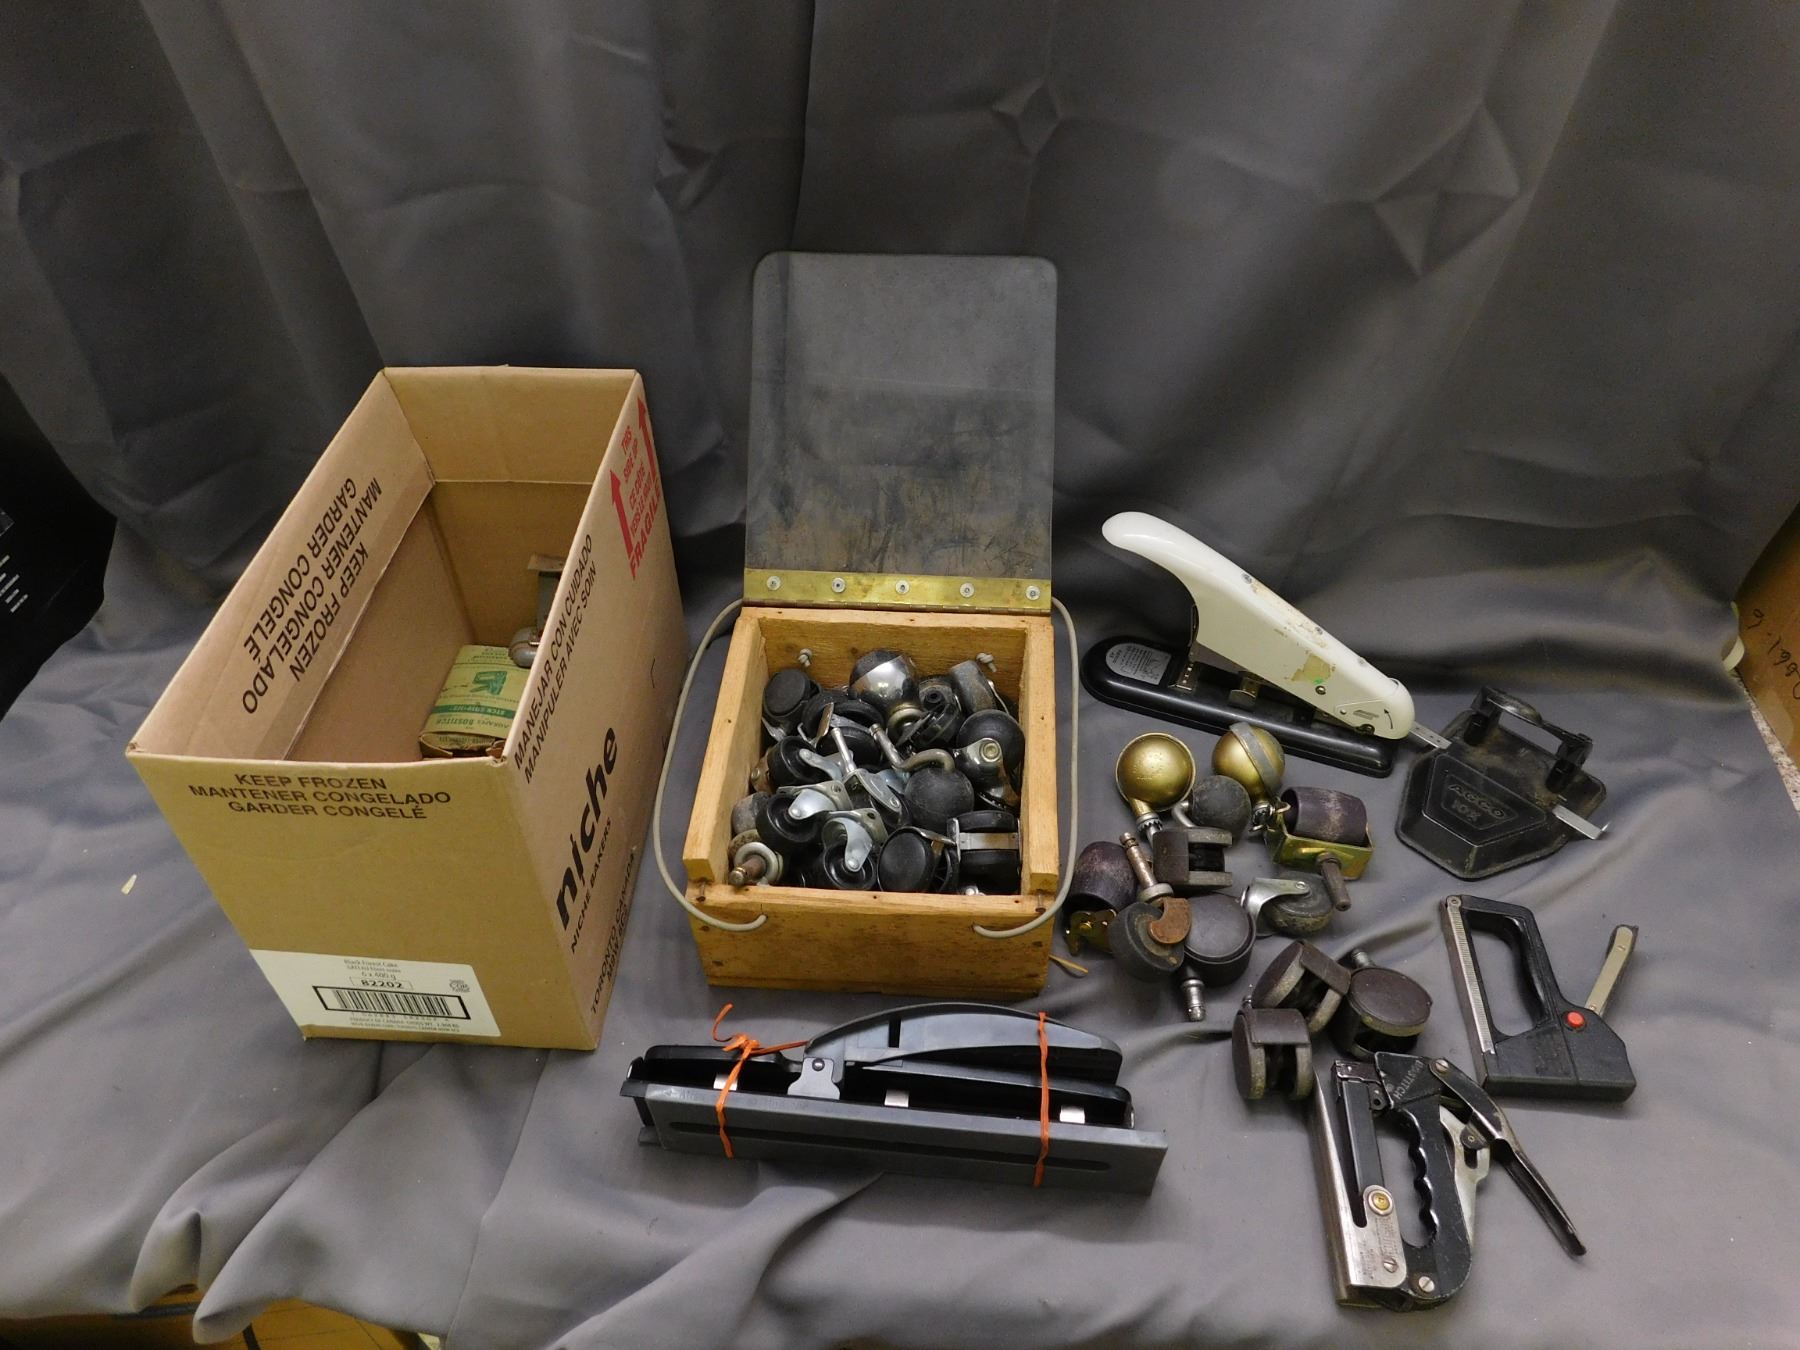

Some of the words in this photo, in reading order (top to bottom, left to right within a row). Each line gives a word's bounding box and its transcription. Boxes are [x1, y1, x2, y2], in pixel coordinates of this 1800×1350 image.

[306, 478, 357, 559] GARDER
[321, 477, 382, 580] MANTENER
[629, 477, 661, 581] FRAGILE
[243, 554, 310, 665] CONGELÉ
[340, 542, 369, 599] KEEP
[242, 576, 324, 714] CONGELADO
[289, 592, 341, 683] FROZEN
[513, 659, 553, 771] MANEJAR
[550, 612, 566, 662] CON
[564, 533, 592, 618] CUIDADO
[524, 662, 567, 785] MANIPULER
[566, 605, 582, 658] AVEC
[581, 560, 597, 609] SOIN
[188, 785, 312, 803] MANTENER
[312, 791, 451, 805] CONGELADO
[228, 801, 319, 816] GARDER
[323, 804, 427, 819] CONGELÉ
[234, 773, 293, 788] KEEP
[297, 777, 387, 790] FROZEN
[556, 727, 618, 931] niche
[1447, 784, 1506, 819] ACCO
[571, 891, 591, 954] NICHE
[590, 817, 612, 889] BAKERS
[591, 925, 617, 1015] TORONTO
[615, 852, 635, 924] CANADA
[360, 979, 404, 989] 82202
[1393, 1060, 1424, 1100] BOSTITCH
